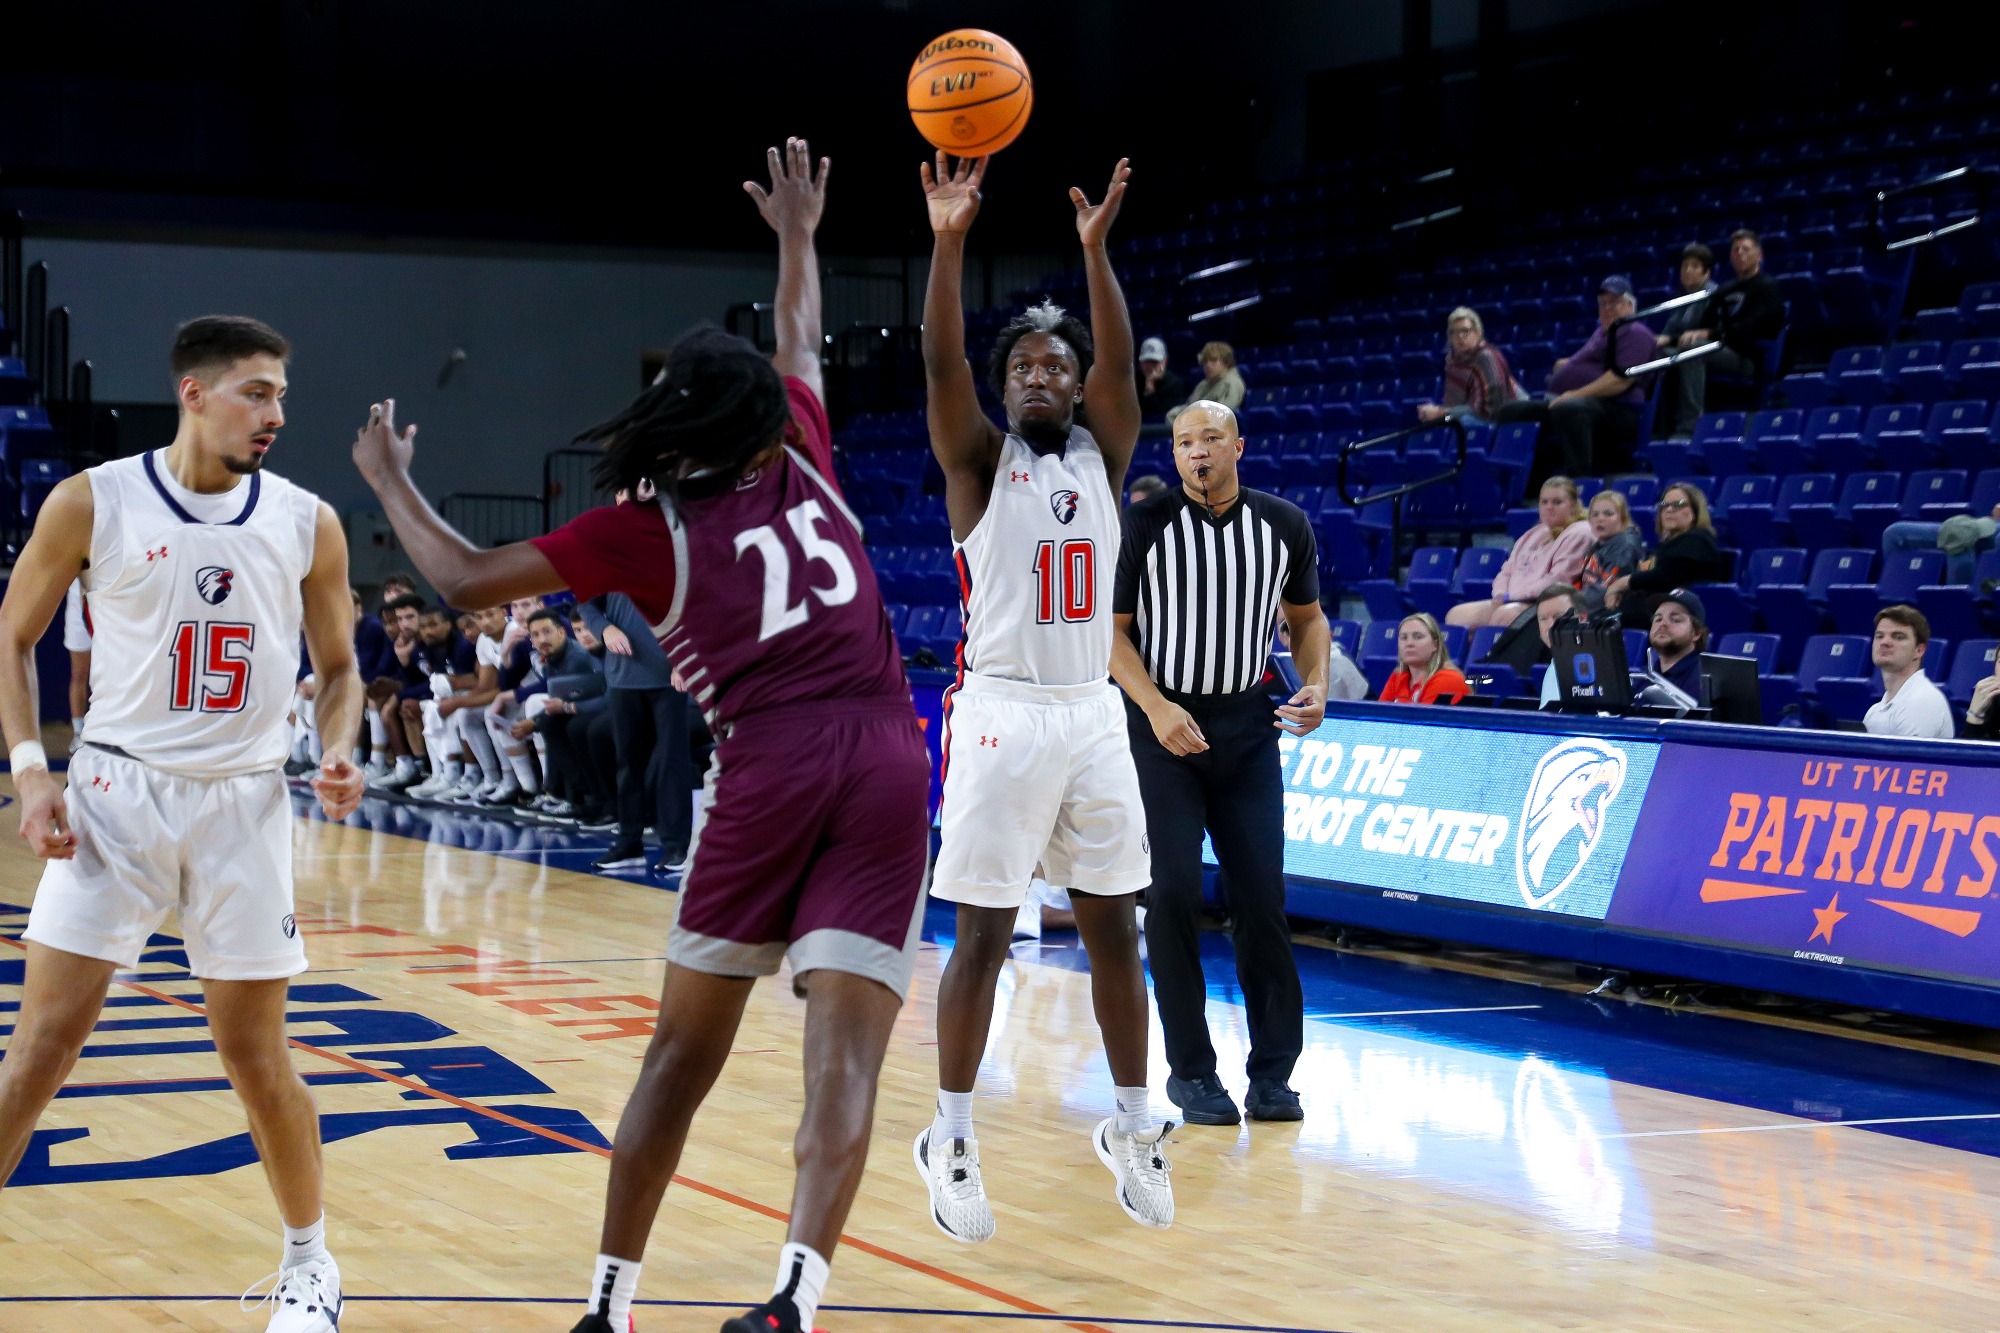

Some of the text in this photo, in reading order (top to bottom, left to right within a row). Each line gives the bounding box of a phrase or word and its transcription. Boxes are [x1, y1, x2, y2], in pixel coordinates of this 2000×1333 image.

[918, 37, 995, 65] Wilson
[733, 499, 858, 643] 25
[1032, 538, 1096, 624] 10
[168, 621, 255, 713] 15
[1291, 739, 1343, 789] TO
[1342, 744, 1422, 797] THE
[1801, 761, 1949, 797] UT TYLER
[1283, 791, 1509, 866] RIOT CENTER
[1709, 792, 2000, 898] PATRIOTS
[1793, 950, 1845, 965] DAKTRONICS
